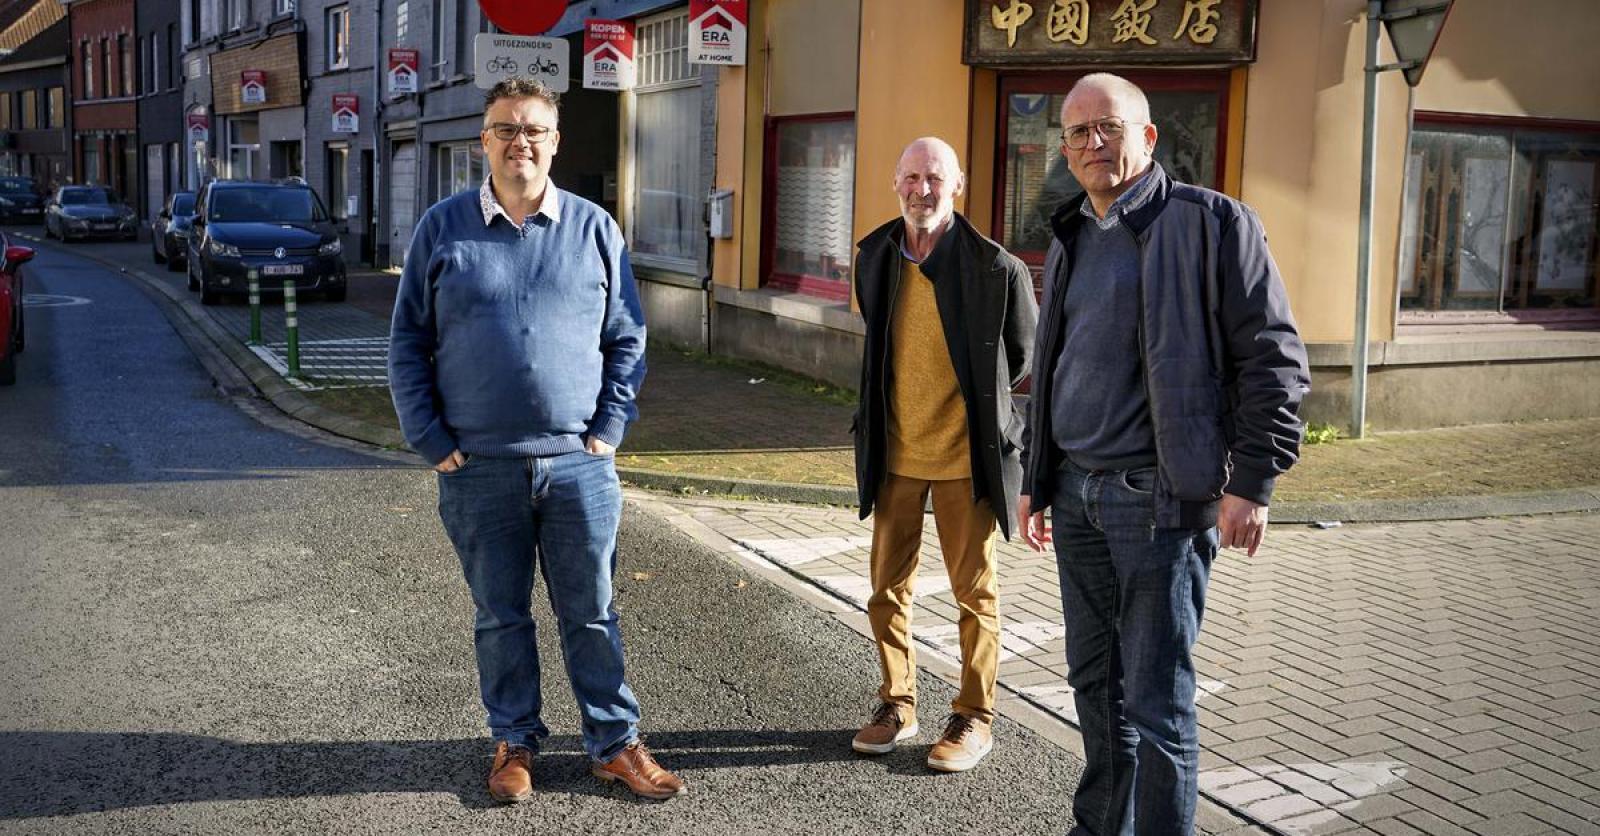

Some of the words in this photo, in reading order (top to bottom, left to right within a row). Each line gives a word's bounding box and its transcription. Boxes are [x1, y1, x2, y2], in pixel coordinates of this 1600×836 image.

[591, 23, 625, 33] KOPEN
[992, 0, 1221, 48] 中國飯店
[702, 31, 730, 42] ERA
[494, 39, 553, 49] UITGEZONDERD
[594, 62, 617, 72] ERA
